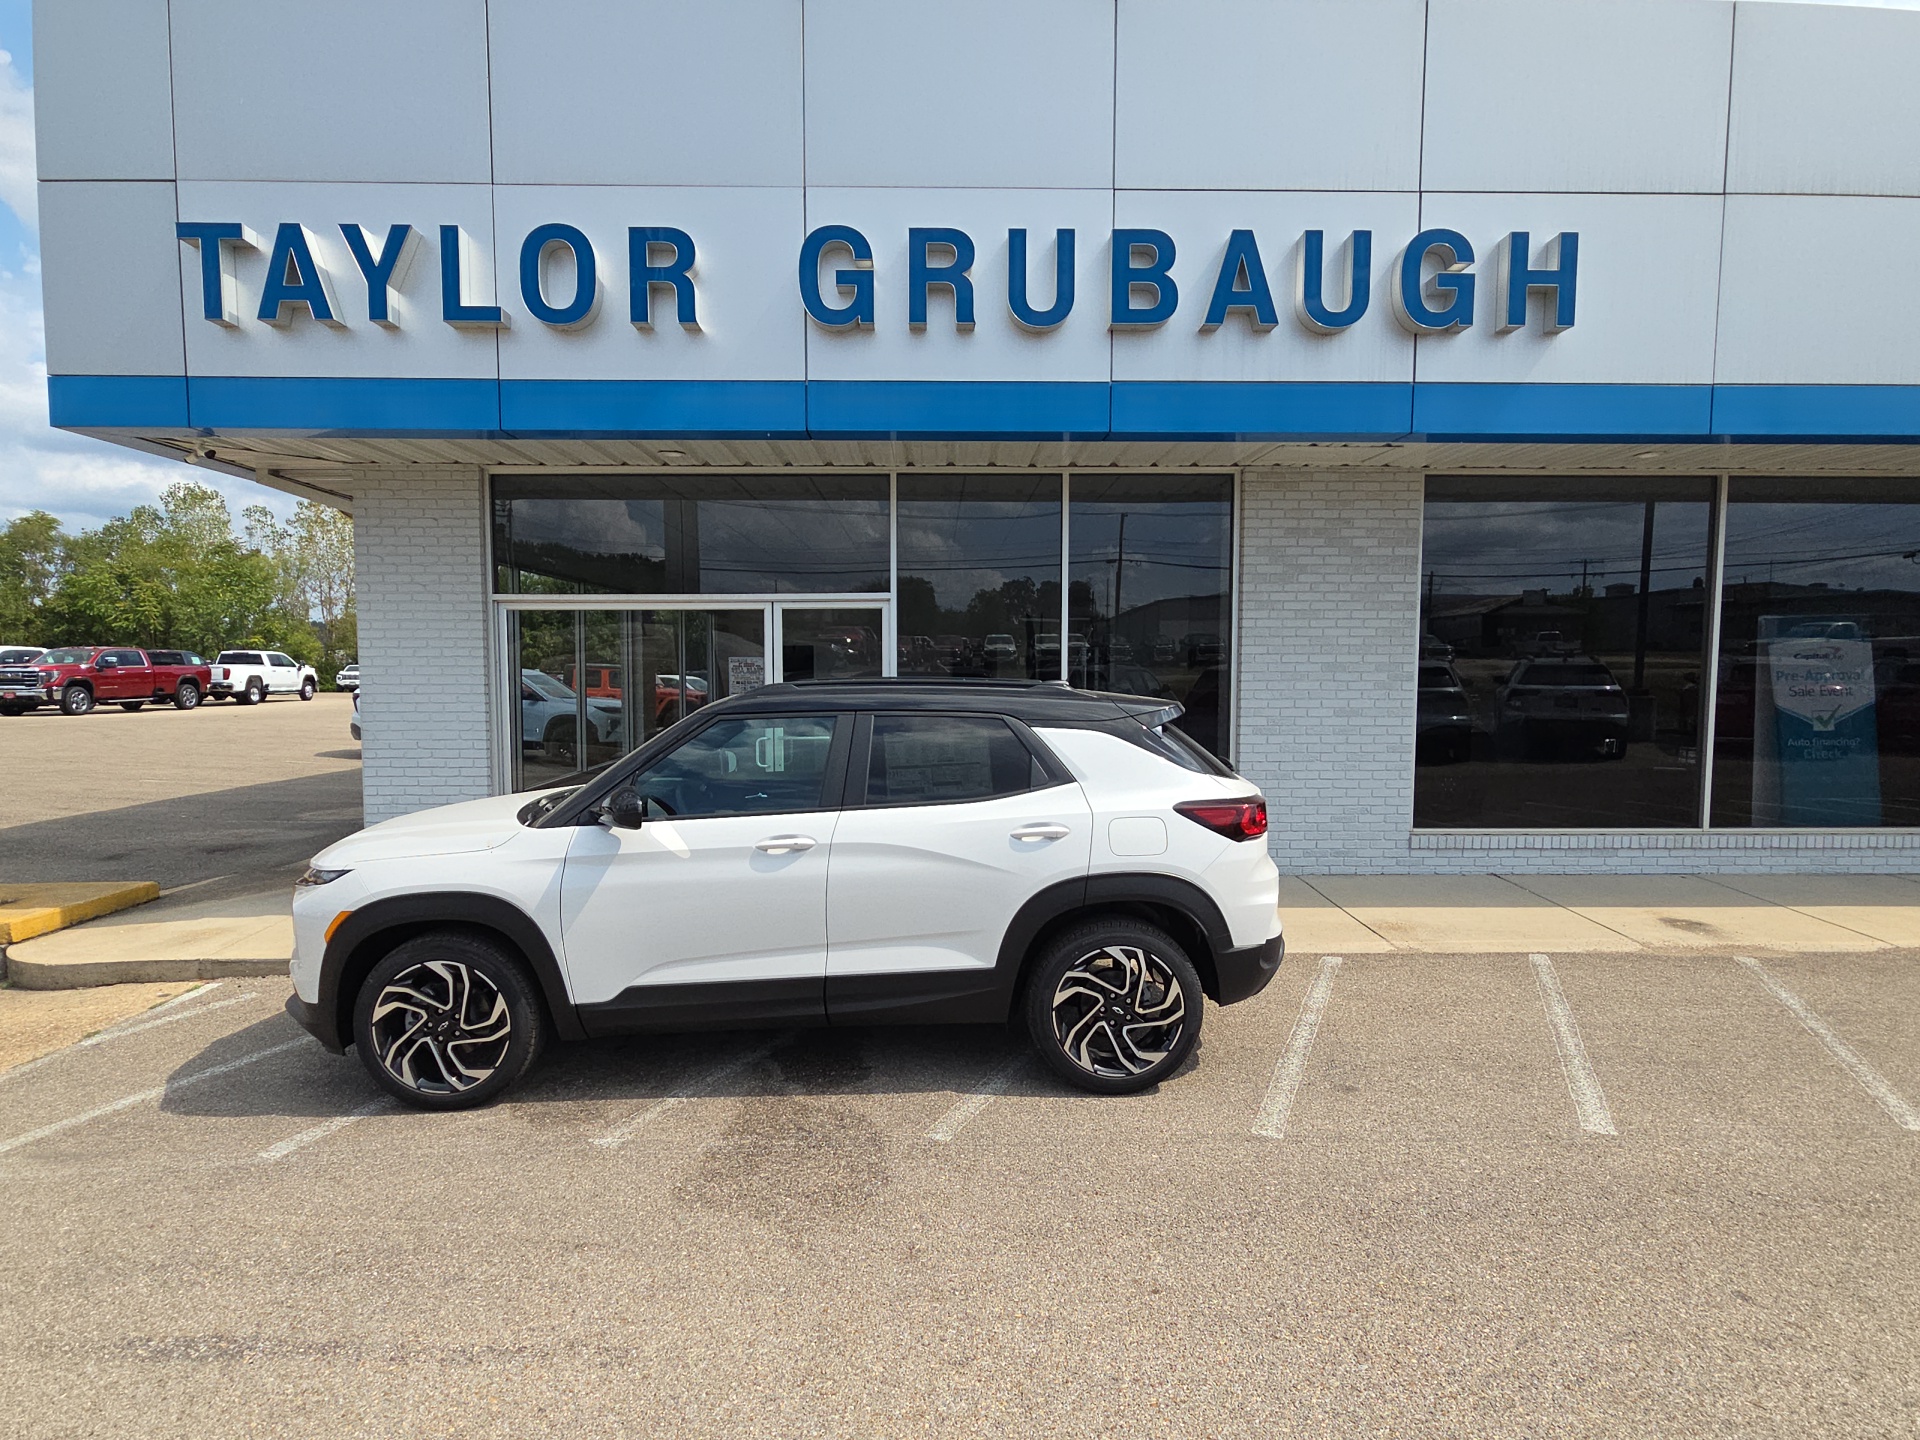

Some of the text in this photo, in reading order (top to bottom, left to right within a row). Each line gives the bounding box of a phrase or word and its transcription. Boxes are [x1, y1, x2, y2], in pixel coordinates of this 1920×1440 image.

[176, 222, 1579, 333] TAYLOR GRUBAUGH
[1775, 669, 1863, 684] Pre-Approval
[1788, 685, 1854, 697] Sale Event
[1787, 737, 1860, 748] Auto financing?
